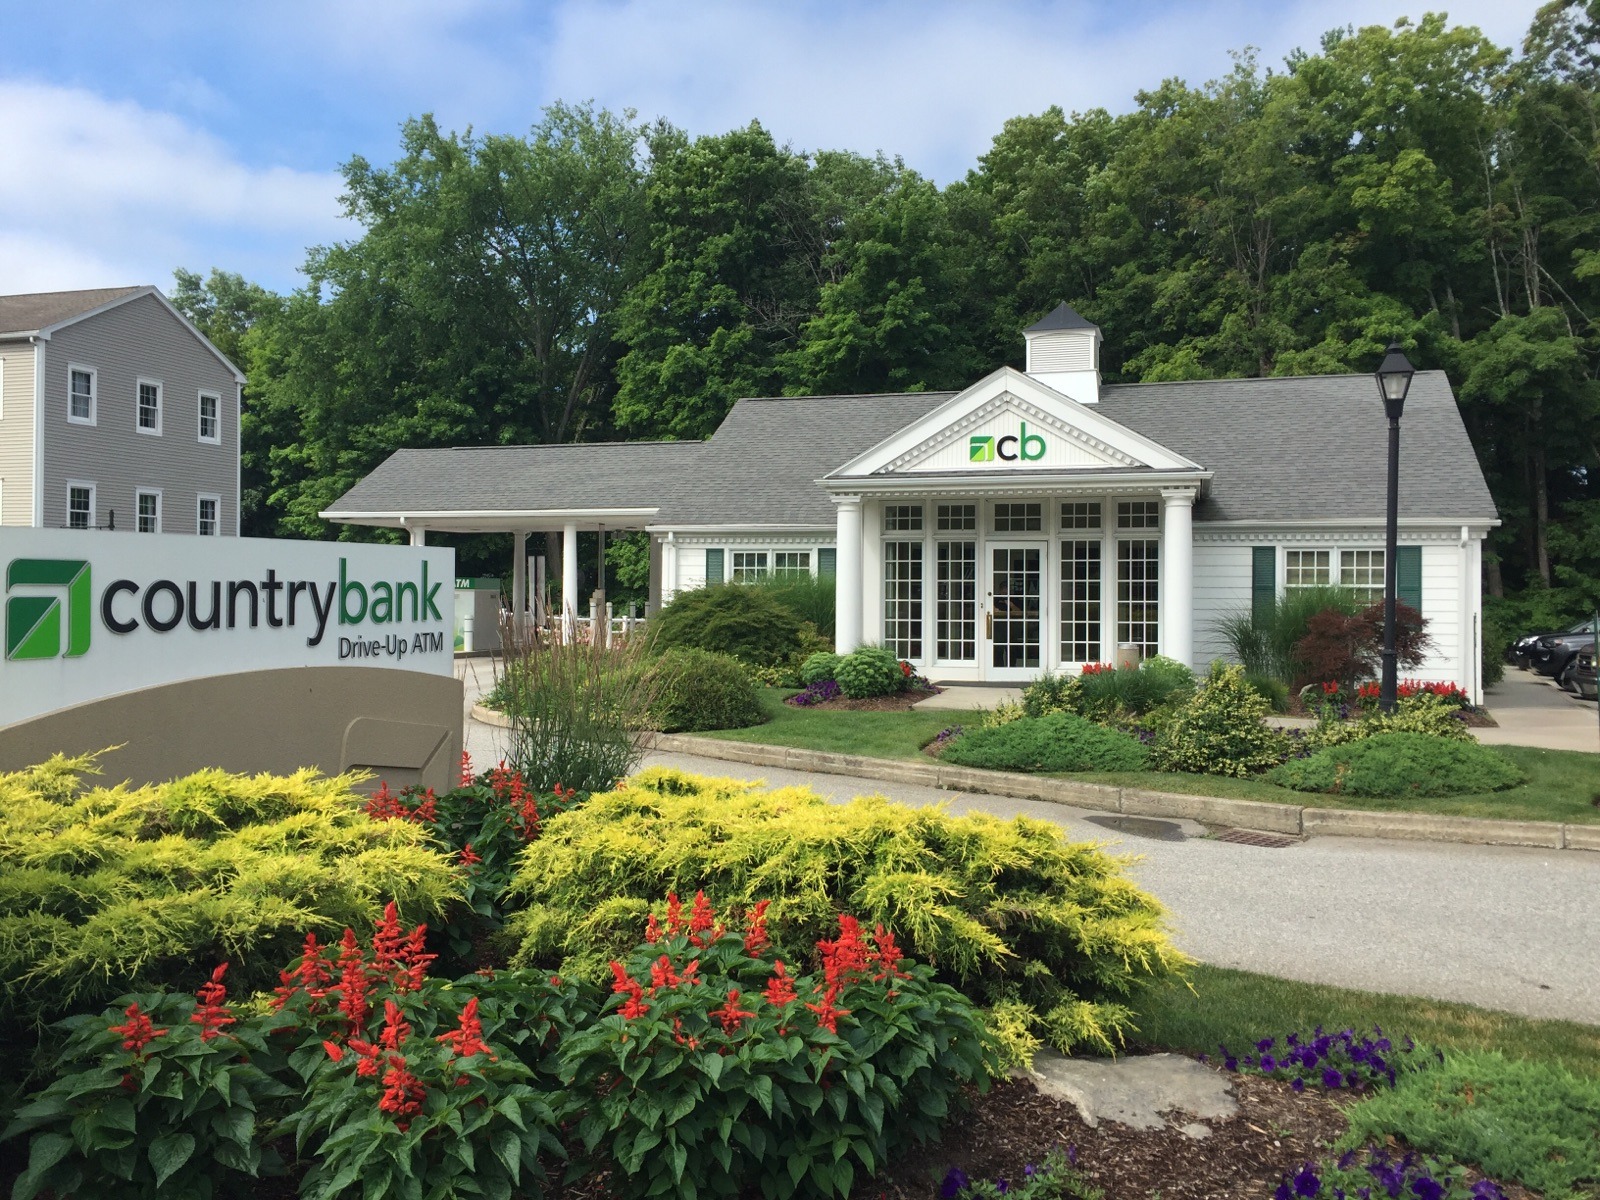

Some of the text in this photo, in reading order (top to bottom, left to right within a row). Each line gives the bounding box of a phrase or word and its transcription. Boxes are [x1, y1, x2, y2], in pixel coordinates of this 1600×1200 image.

[996, 421, 1046, 461] cb
[455, 578, 470, 588] TM
[100, 557, 443, 647] countrybank
[338, 631, 444, 661] Drive-Up ATM
